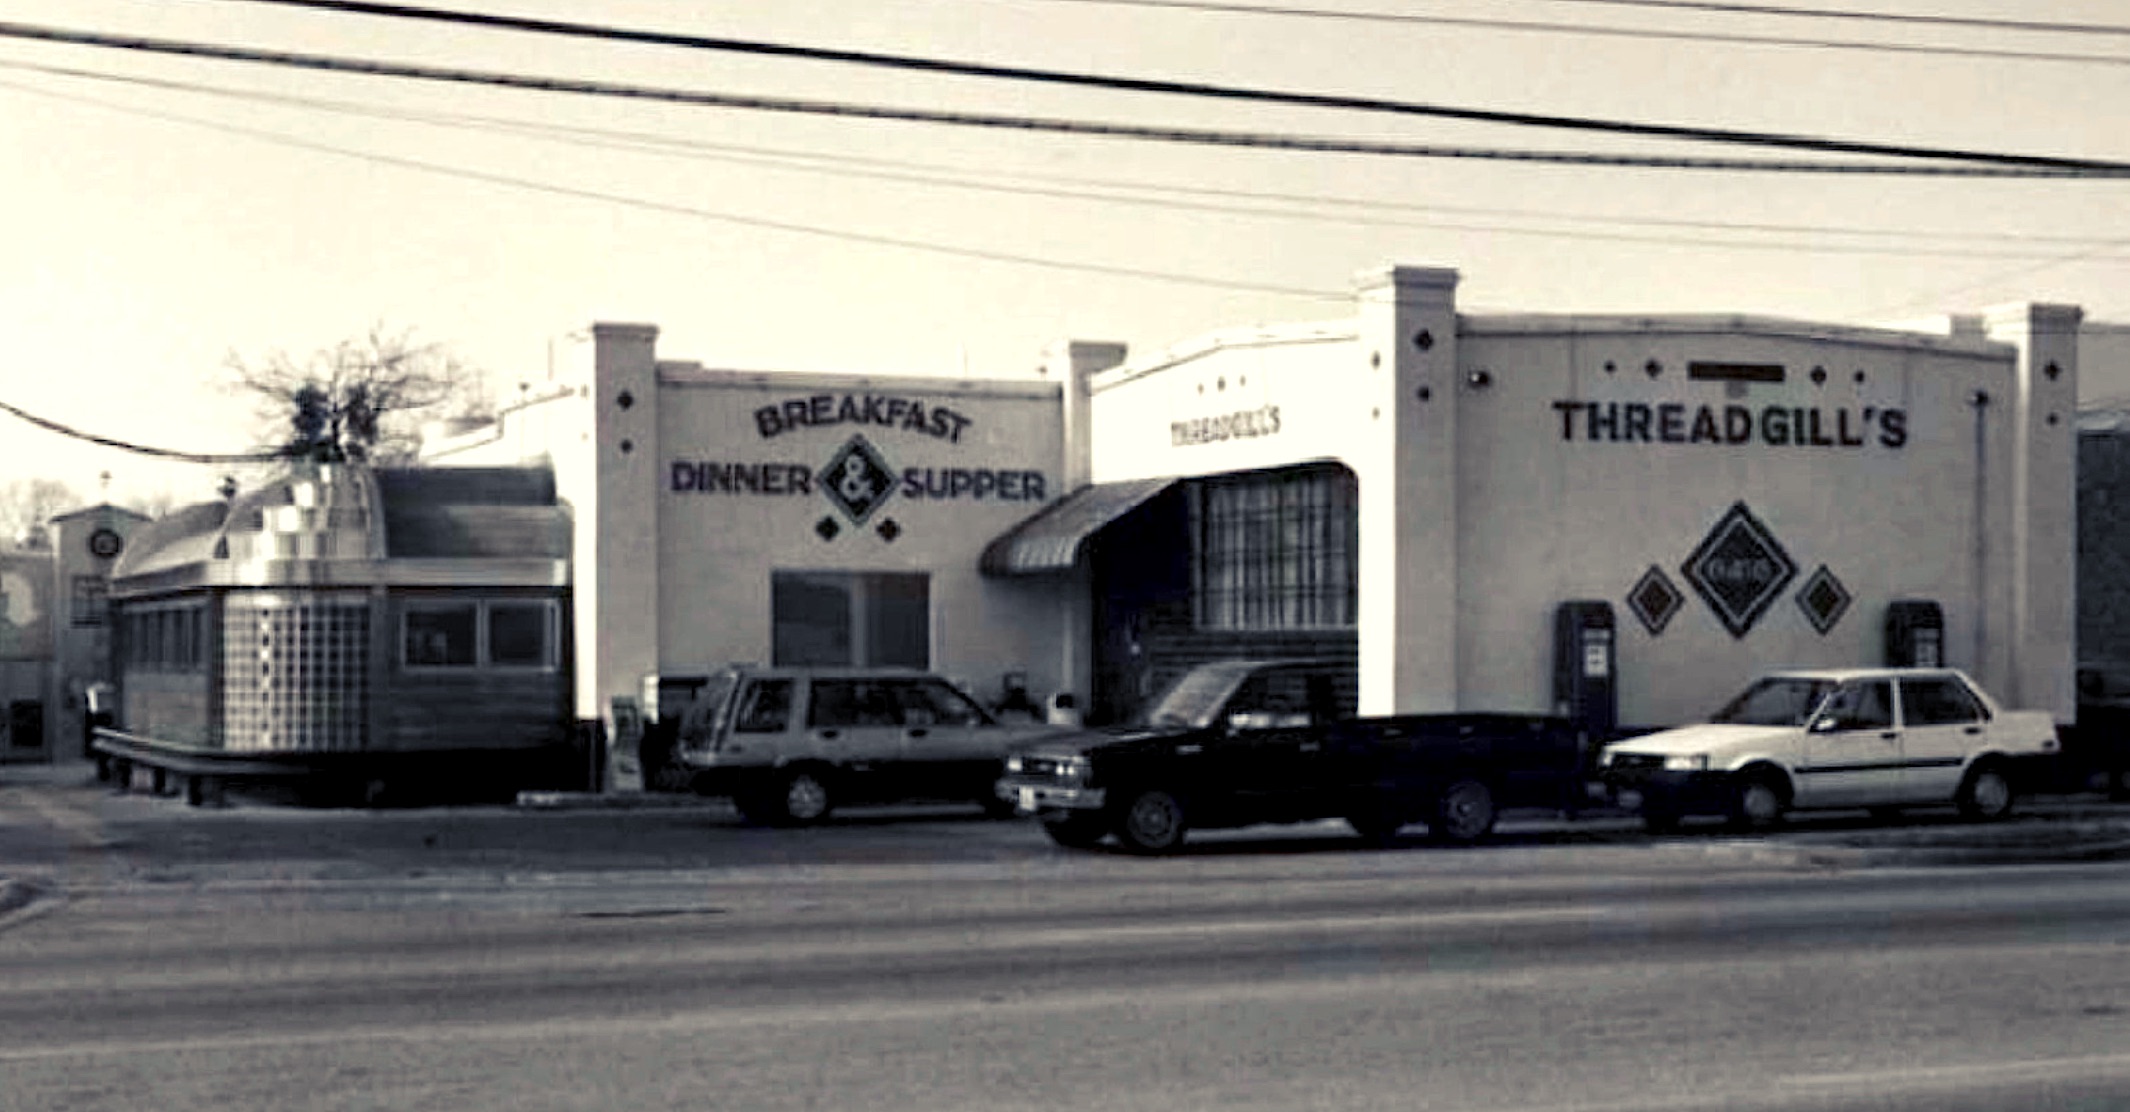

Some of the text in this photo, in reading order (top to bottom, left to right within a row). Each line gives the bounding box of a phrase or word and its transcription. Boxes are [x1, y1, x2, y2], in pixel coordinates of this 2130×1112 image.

[753, 394, 972, 443] BREAKFAST
[1553, 401, 1908, 449] THREADGILL'S
[670, 454, 1048, 500] DINNER & SUPPER
